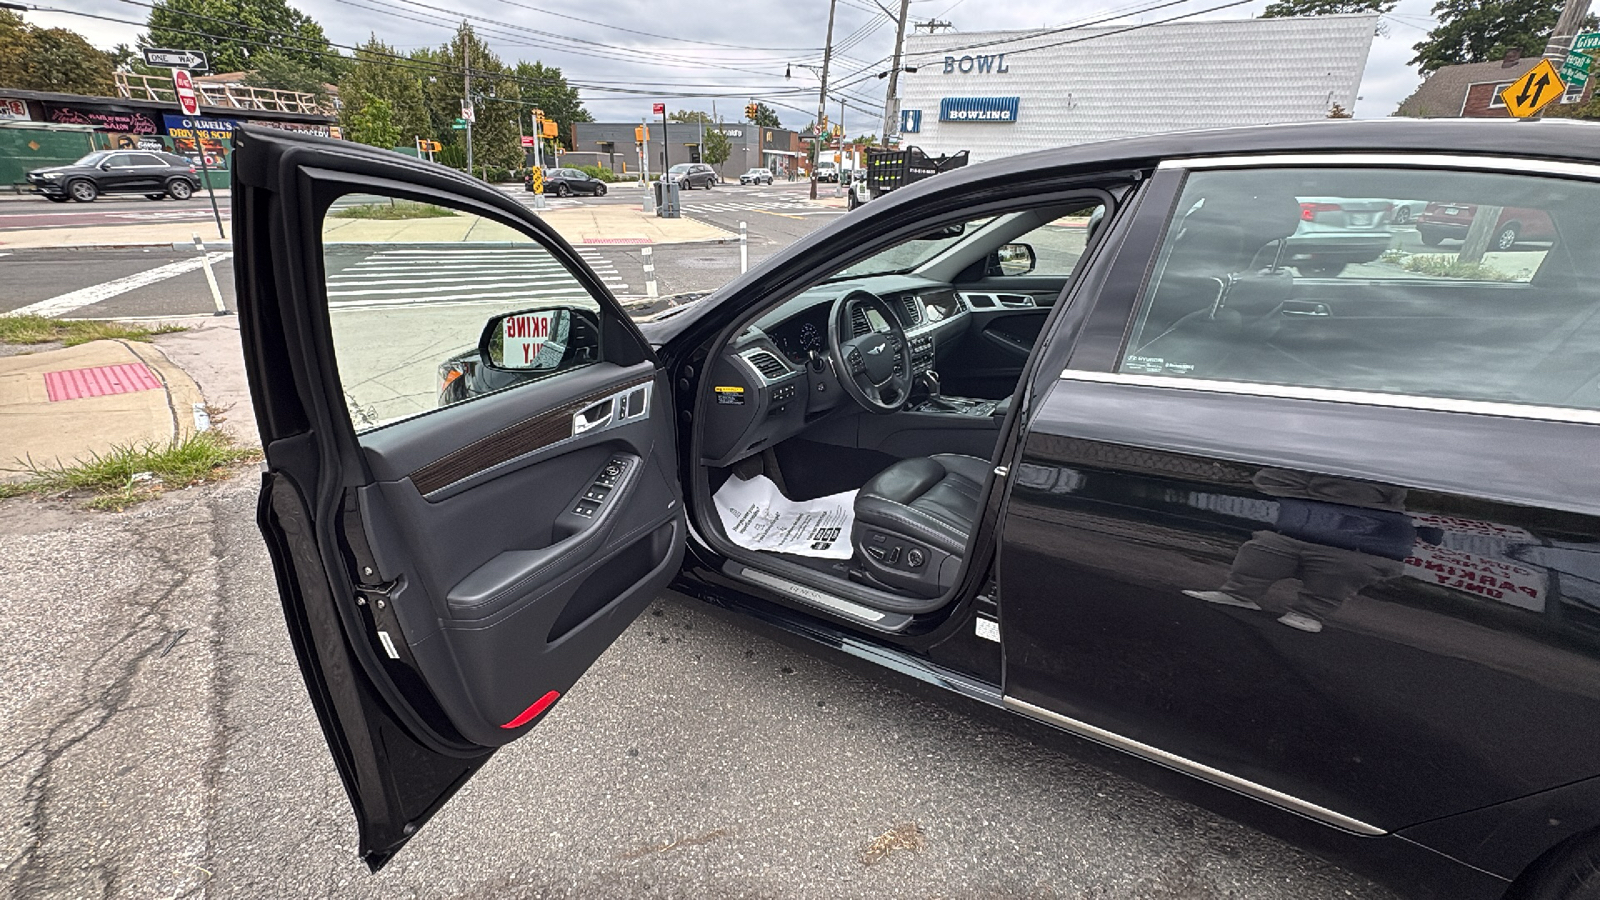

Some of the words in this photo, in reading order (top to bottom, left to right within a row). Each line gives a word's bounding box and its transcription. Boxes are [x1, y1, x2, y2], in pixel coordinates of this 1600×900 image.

[943, 54, 1009, 74] BOWL
[950, 111, 1010, 119] BOWLING
[182, 119, 232, 130] CLWELL'S
[169, 128, 209, 138] DRIVNG
